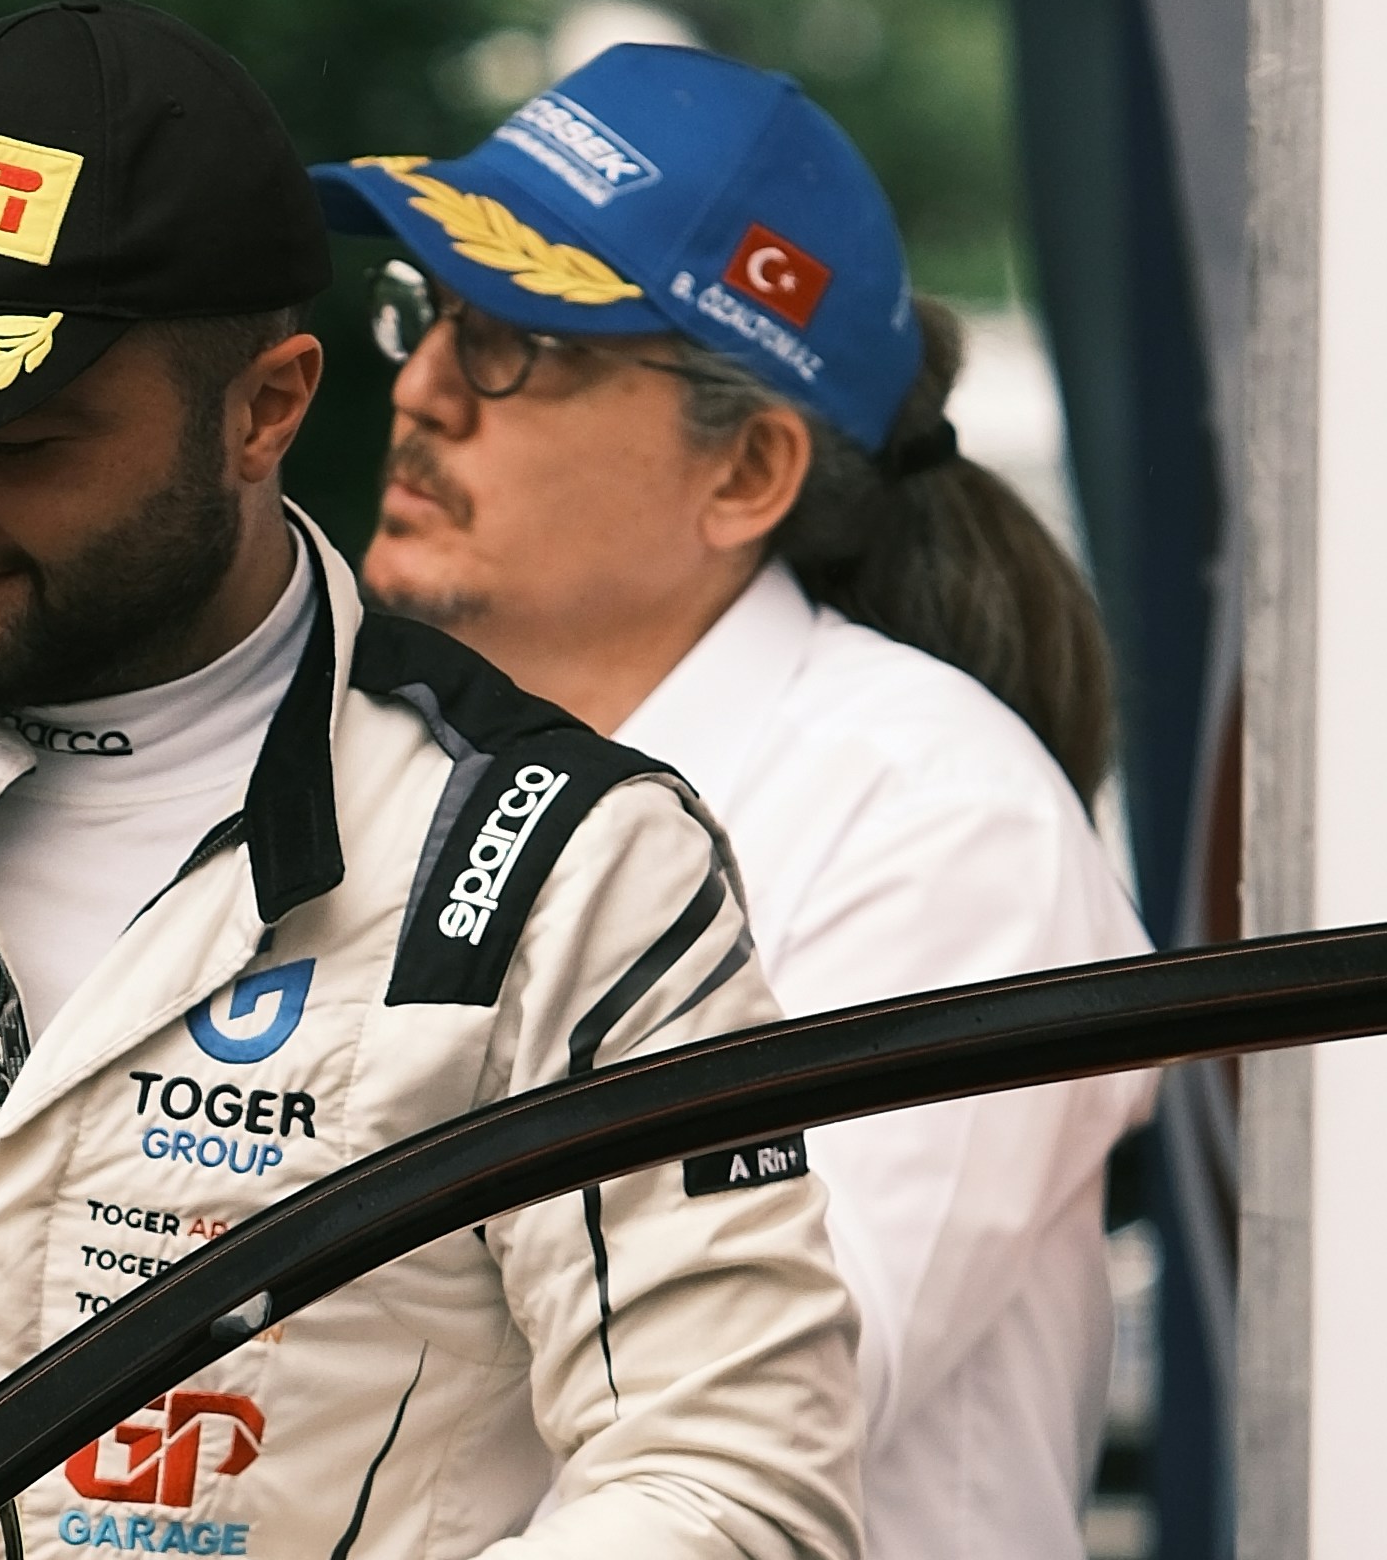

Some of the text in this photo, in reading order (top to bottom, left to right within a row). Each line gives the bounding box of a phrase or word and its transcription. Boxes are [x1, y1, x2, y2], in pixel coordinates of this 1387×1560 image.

[437, 764, 570, 946] sparco
[129, 1070, 317, 1138] TOGER
[141, 1127, 284, 1177] GROUP
[729, 1153, 751, 1182] A
[87, 1198, 181, 1237] TOGER
[58, 1509, 251, 1558] GARAGE
